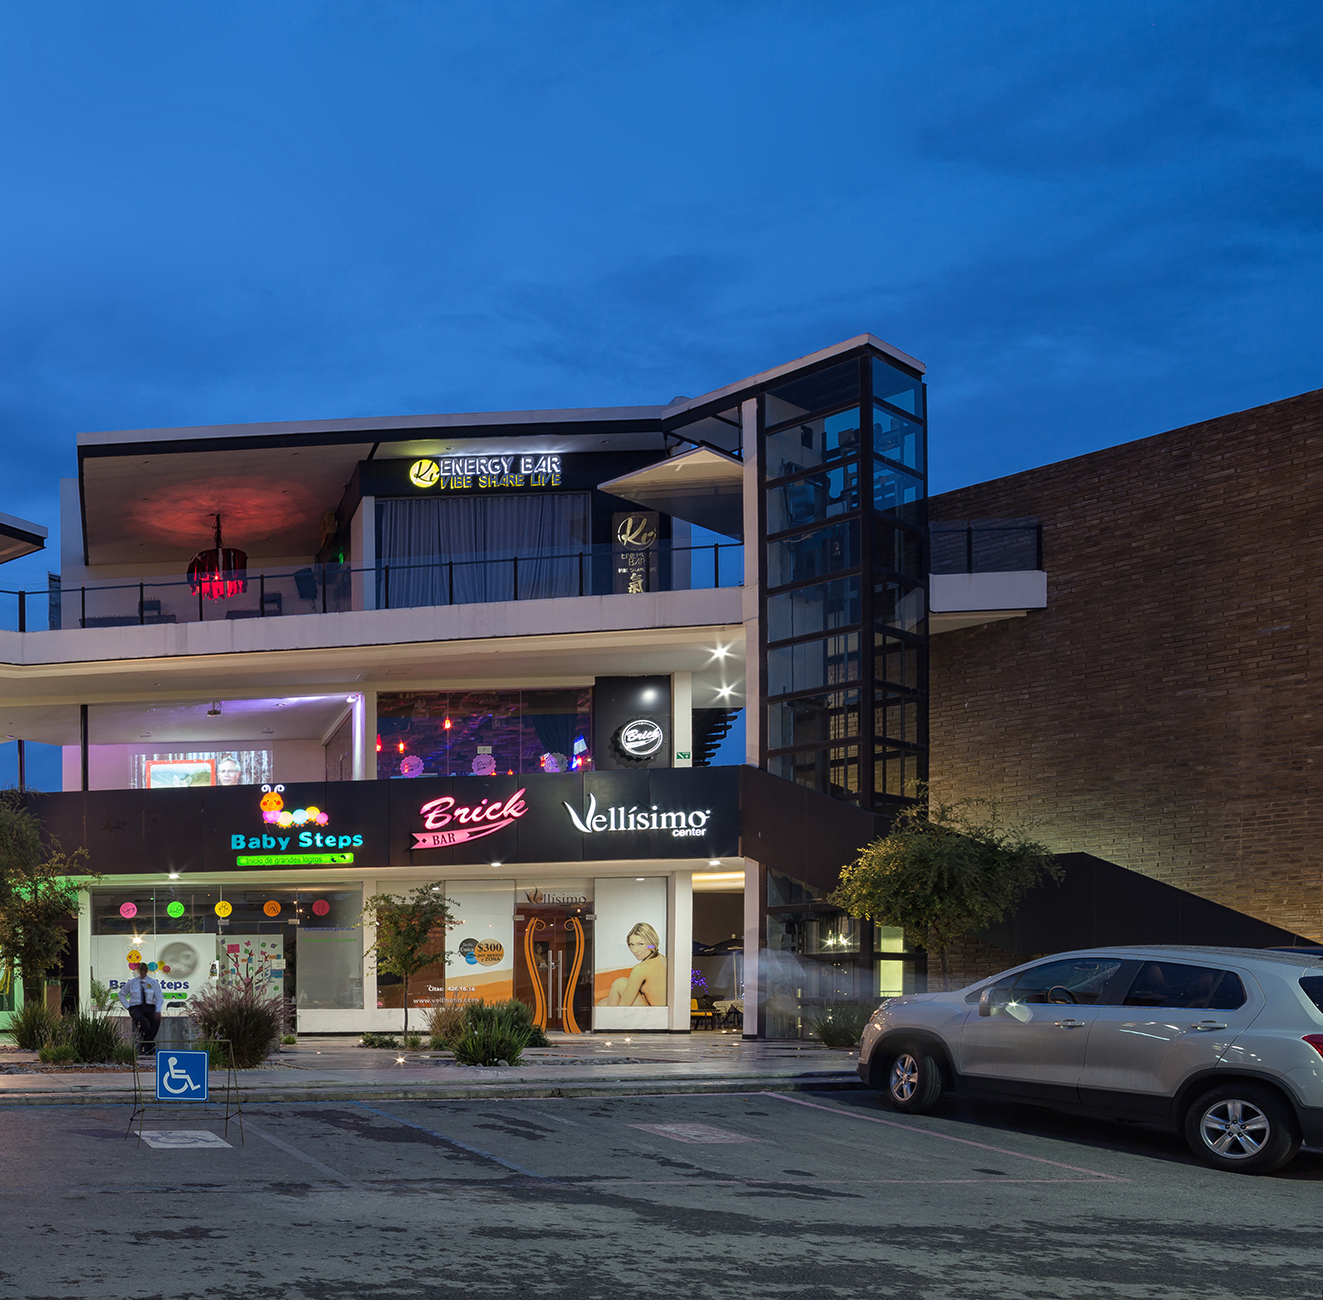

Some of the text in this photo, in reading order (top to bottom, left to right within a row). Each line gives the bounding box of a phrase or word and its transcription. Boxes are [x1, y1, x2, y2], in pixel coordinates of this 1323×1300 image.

[440, 454, 562, 476] ENERGY BAR
[440, 472, 562, 489] VIBE SHARE LIVE
[420, 787, 530, 831] Brick
[562, 792, 711, 834] Vellísimo
[231, 831, 364, 851] Baby Steps
[432, 832, 456, 846] BAR
[672, 828, 707, 838] center
[477, 942, 502, 953] $300
[156, 979, 190, 991] teps
